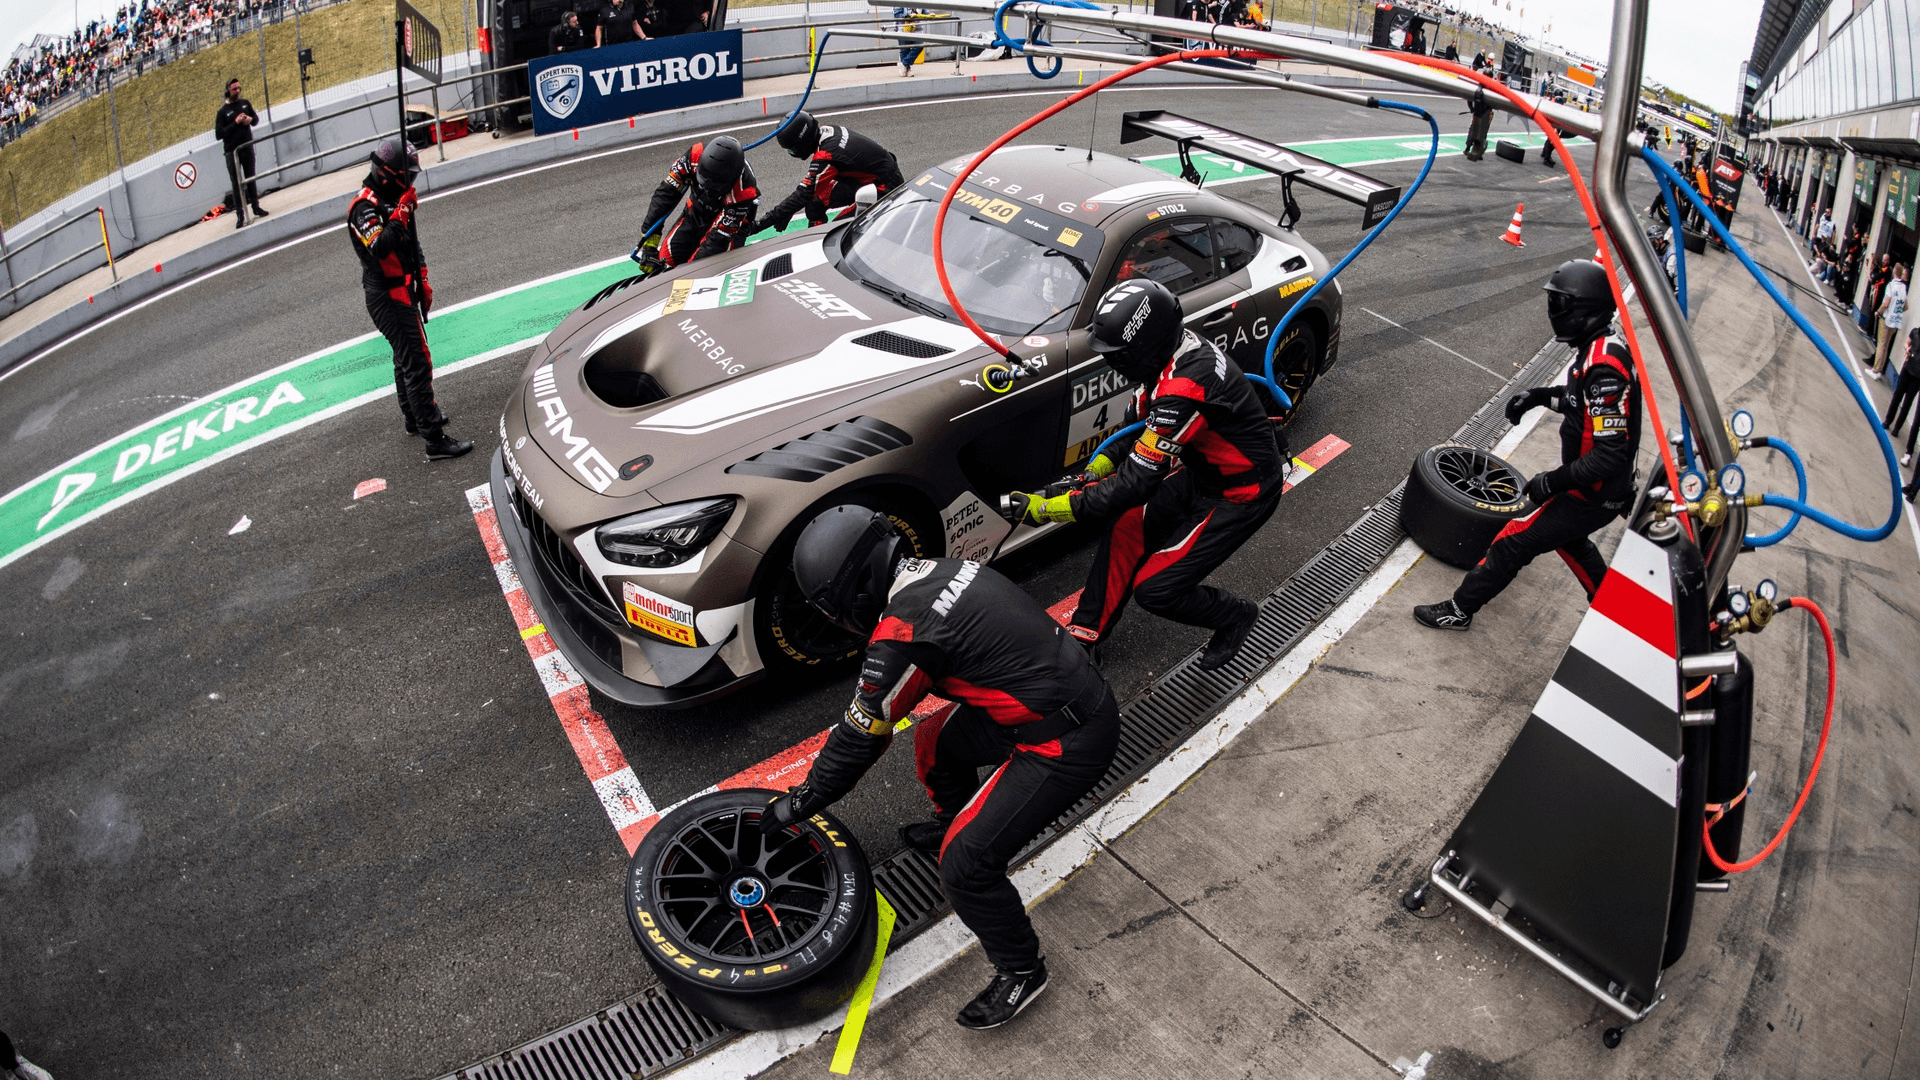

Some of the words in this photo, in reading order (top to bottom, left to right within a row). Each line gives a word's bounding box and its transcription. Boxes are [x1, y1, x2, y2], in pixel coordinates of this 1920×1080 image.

[539, 69, 561, 82] EXPERT
[560, 65, 574, 76] KITS
[589, 50, 738, 97] VIEROL
[1565, 51, 1595, 65] Motorsport
[953, 188, 992, 210] DTM
[987, 203, 1013, 218] 40
[1156, 203, 1187, 216] STOLZ
[691, 287, 718, 296] 4
[727, 270, 752, 306] DEKRA
[810, 306, 828, 320] TEAM
[677, 318, 746, 376] MERBAG
[111, 381, 306, 484] DEKRA
[1092, 404, 1109, 431] 4
[1603, 418, 1627, 427] DTM
[536, 396, 620, 494] AMG
[502, 442, 522, 482] RACING
[520, 474, 545, 511] TEAM
[946, 500, 980, 531] PETEC
[931, 560, 980, 618] MANNO
[635, 592, 692, 626] motorsport
[631, 608, 690, 642] PIRELLI
[771, 626, 807, 661] ZERO
[807, 657, 821, 665] P
[597, 748, 612, 773] TEAM
[766, 757, 808, 782] RACING
[807, 750, 821, 760] TE
[810, 813, 847, 849] ELLI
[843, 871, 856, 896] DTM
[637, 911, 698, 969] ZERO
[698, 967, 722, 979] P
